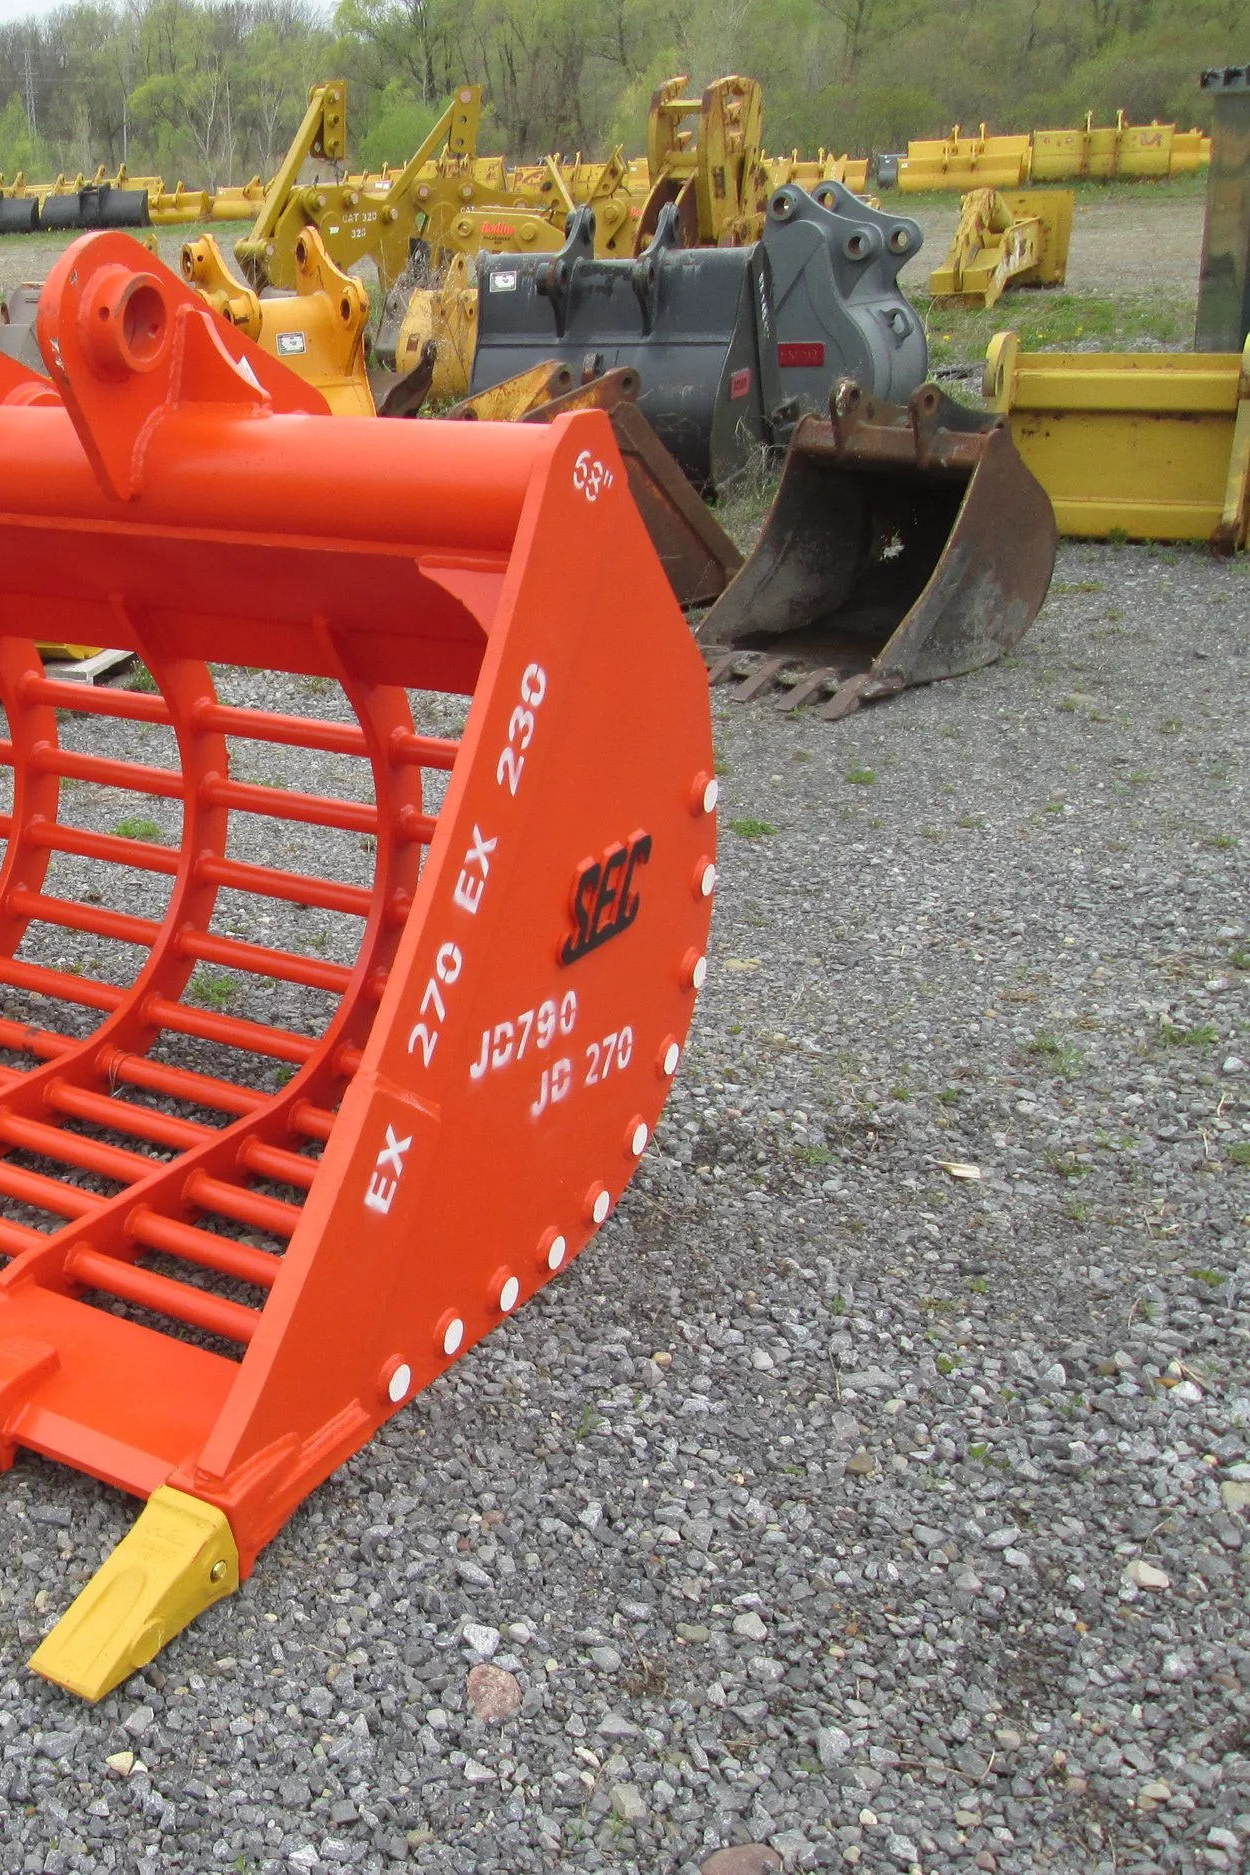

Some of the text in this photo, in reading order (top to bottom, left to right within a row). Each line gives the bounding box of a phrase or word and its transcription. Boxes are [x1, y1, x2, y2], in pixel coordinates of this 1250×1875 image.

[342, 211, 377, 224] CAT 320
[351, 227, 367, 239] 320
[363, 662, 548, 1216] EX 270 EX 230
[559, 833, 652, 966] SEC
[469, 990, 578, 1080] JD790
[530, 1025, 634, 1118] JD 270
